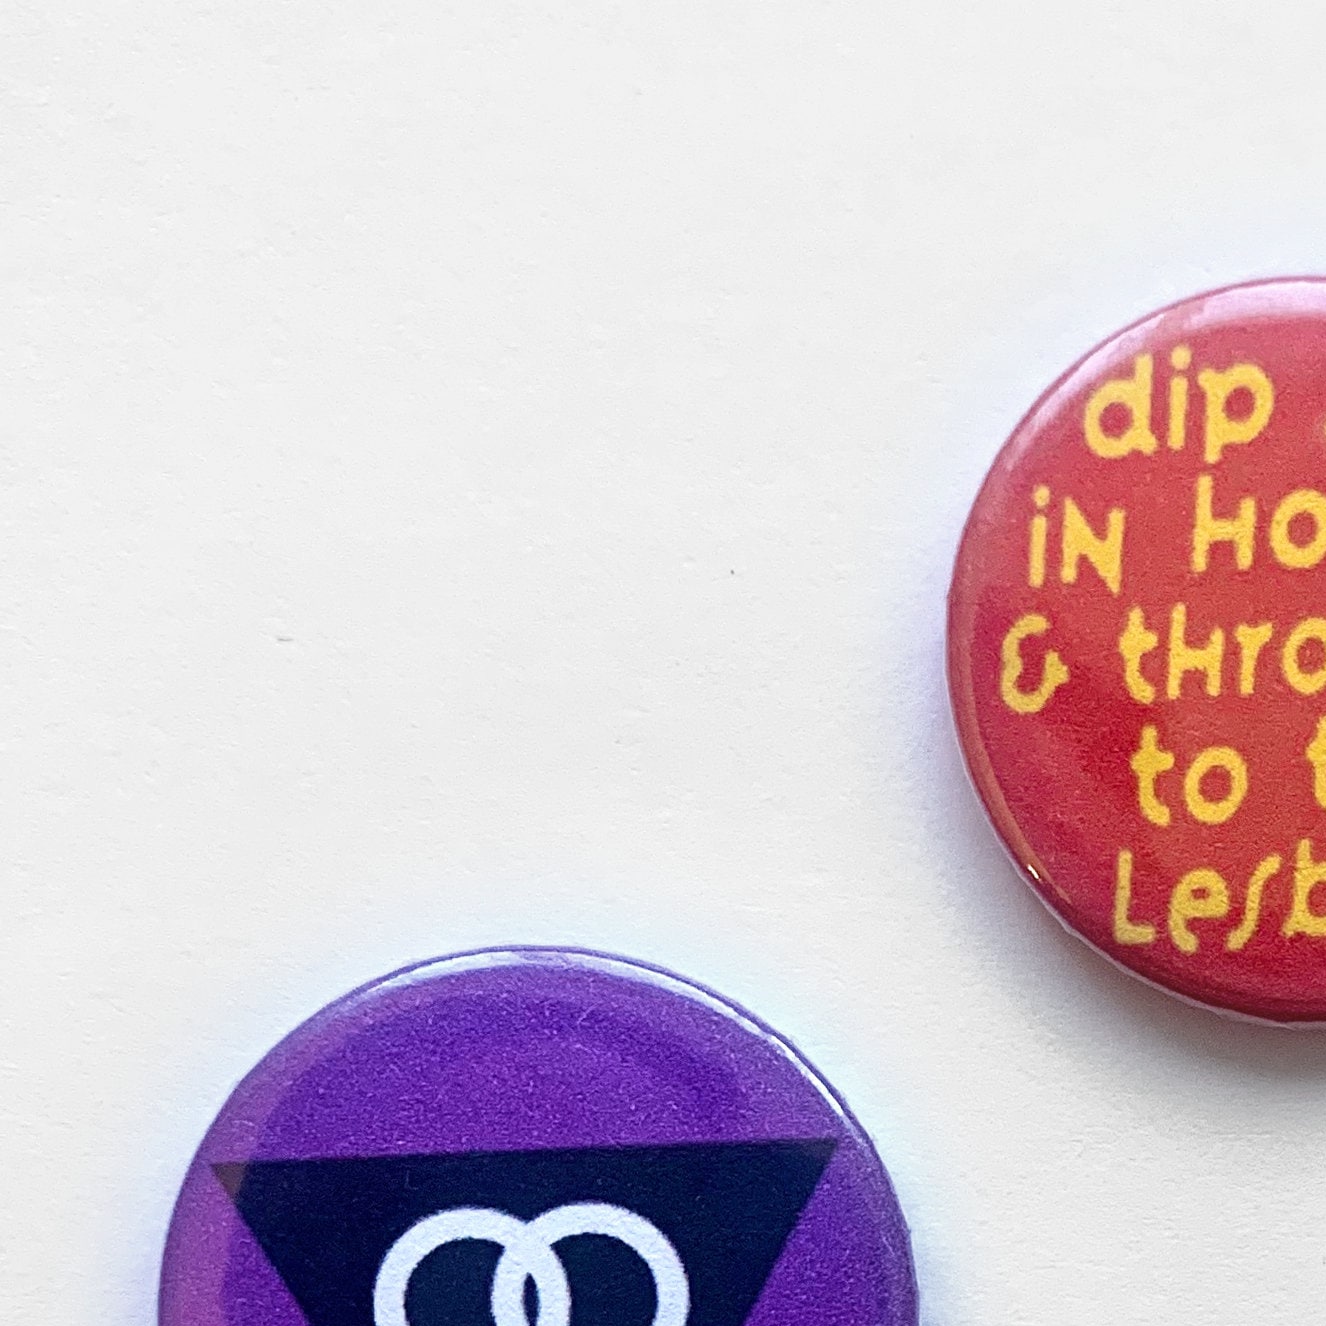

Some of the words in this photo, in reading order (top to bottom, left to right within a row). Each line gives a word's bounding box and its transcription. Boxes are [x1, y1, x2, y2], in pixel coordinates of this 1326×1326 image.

[1082, 344, 1275, 464] dip
[999, 613, 1070, 714] &
[1130, 724, 1249, 827] to
